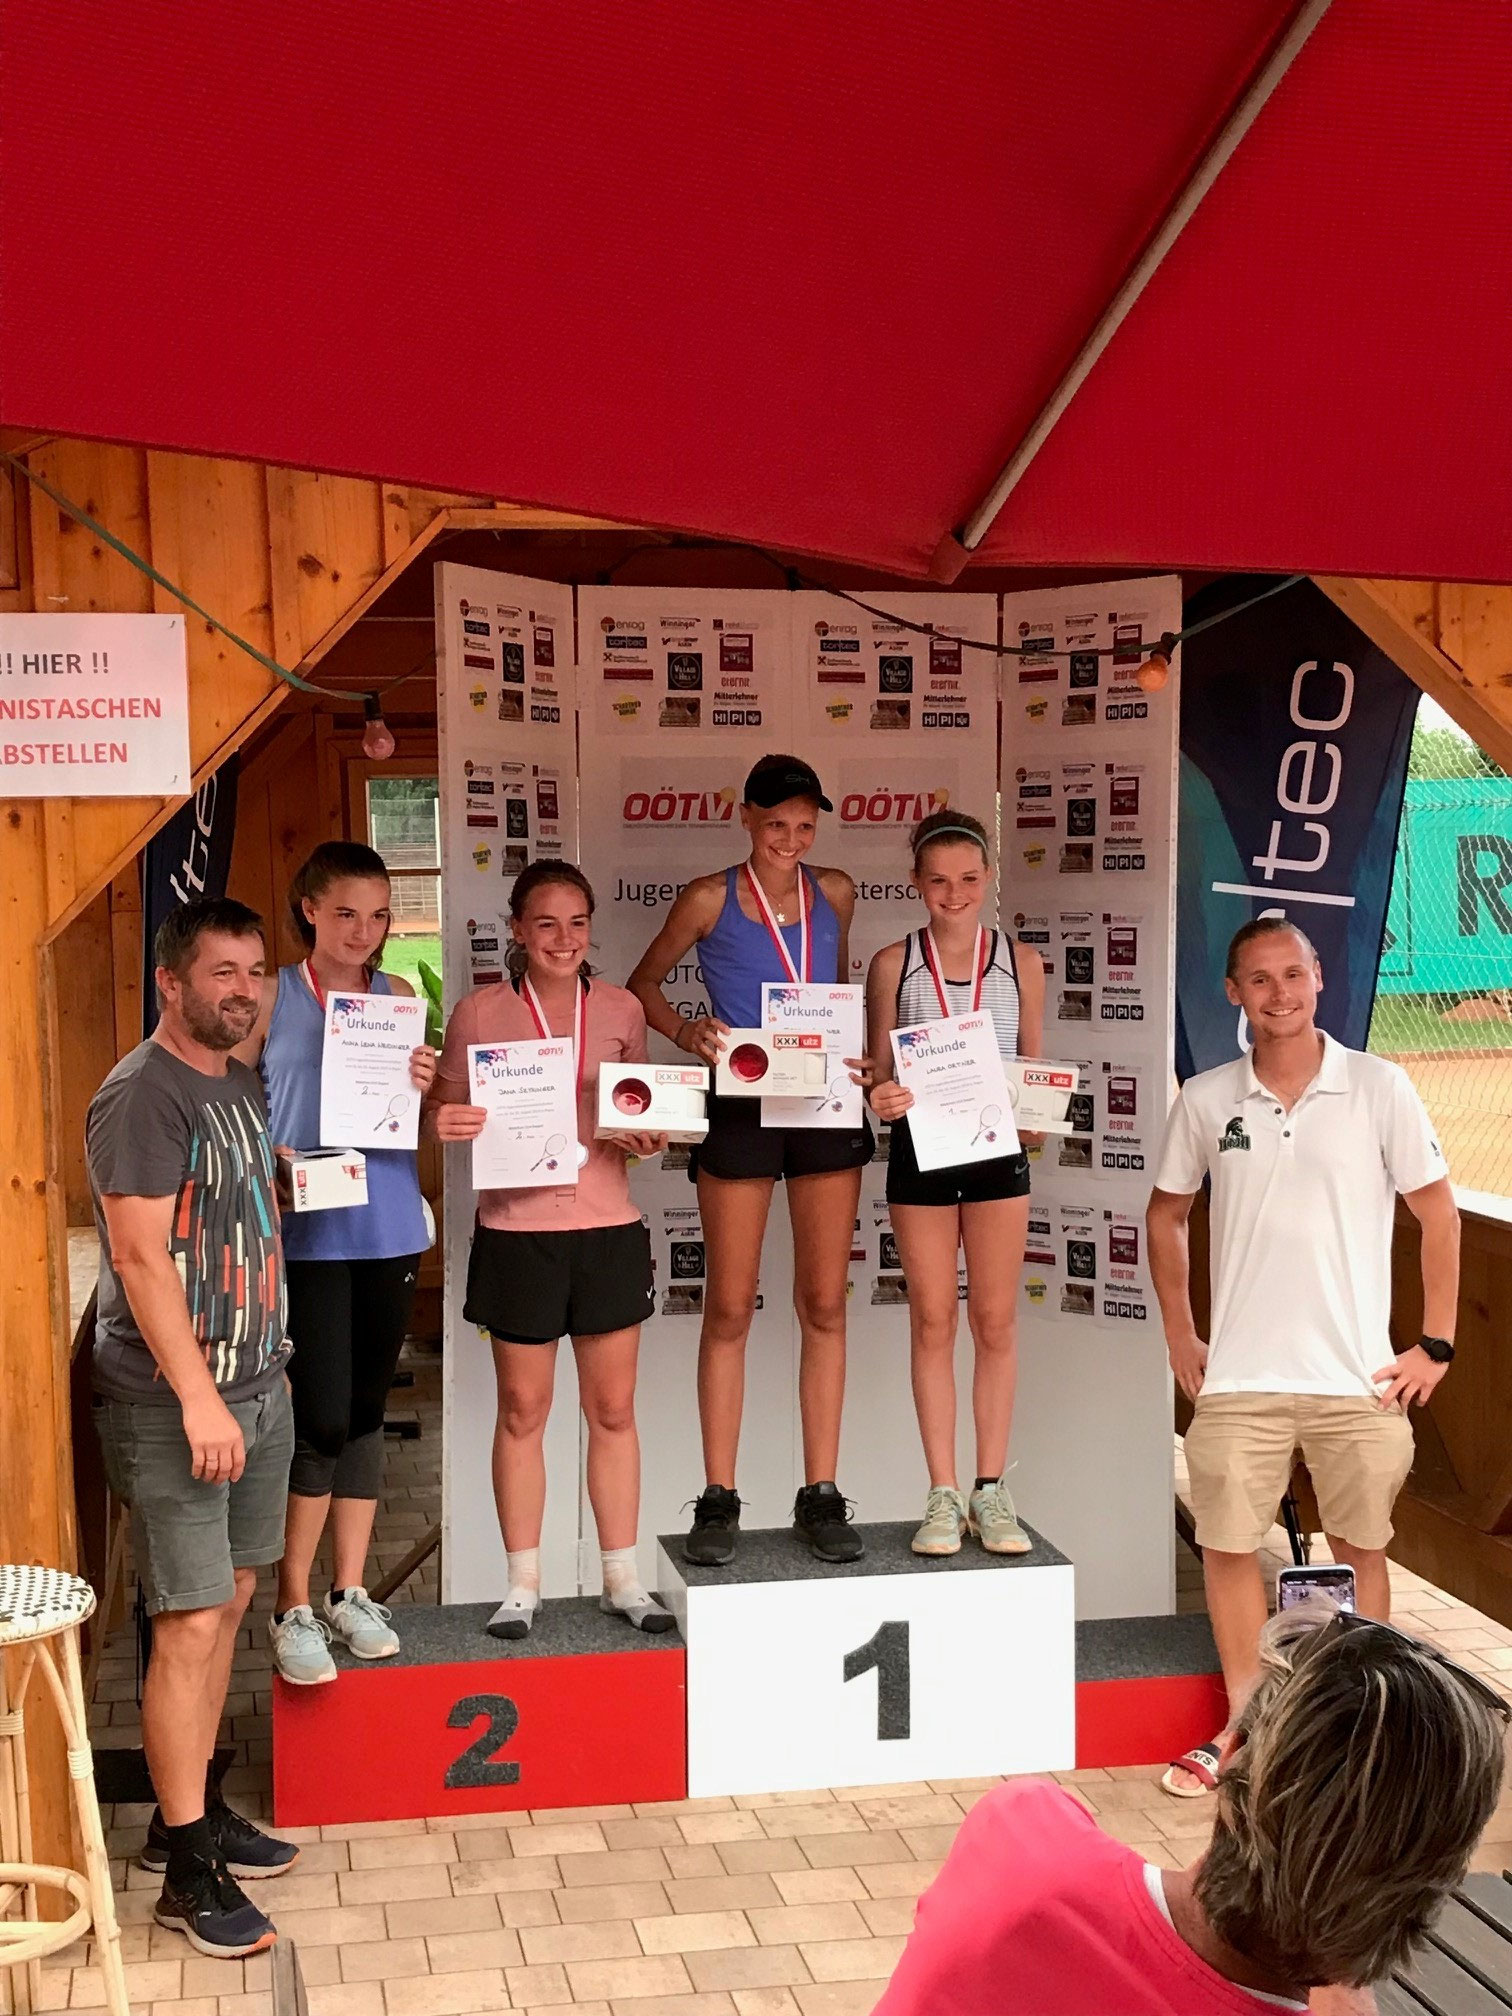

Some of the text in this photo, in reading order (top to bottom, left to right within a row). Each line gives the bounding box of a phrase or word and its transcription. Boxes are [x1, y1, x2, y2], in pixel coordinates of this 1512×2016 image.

[660, 619, 697, 631] Winninger
[22, 653, 83, 675] HIER
[92, 651, 109, 674] !!
[714, 692, 759, 701] Mitterlehner
[924, 695, 968, 703] Mitterlehner
[0, 697, 162, 720] NISTASCHEN
[0, 742, 128, 765] BSTELLEN
[1102, 986, 1142, 996] Mitterlehner
[783, 1006, 834, 1018] Urkunde
[347, 1018, 396, 1032] Urkunde
[342, 1039, 359, 1047] ANNA
[776, 1037, 798, 1046] XXX
[916, 1039, 967, 1059] Urkunde
[492, 1064, 544, 1079] Urkunde
[926, 1058, 977, 1075] LAURA ORTNER
[658, 1073, 680, 1082] XXX
[1027, 1073, 1049, 1083] XXX
[663, 1210, 699, 1220] Winninger
[1105, 1282, 1143, 1294] Mitterlehner
[843, 1620, 911, 1741] 1
[444, 1692, 521, 1788] 2
